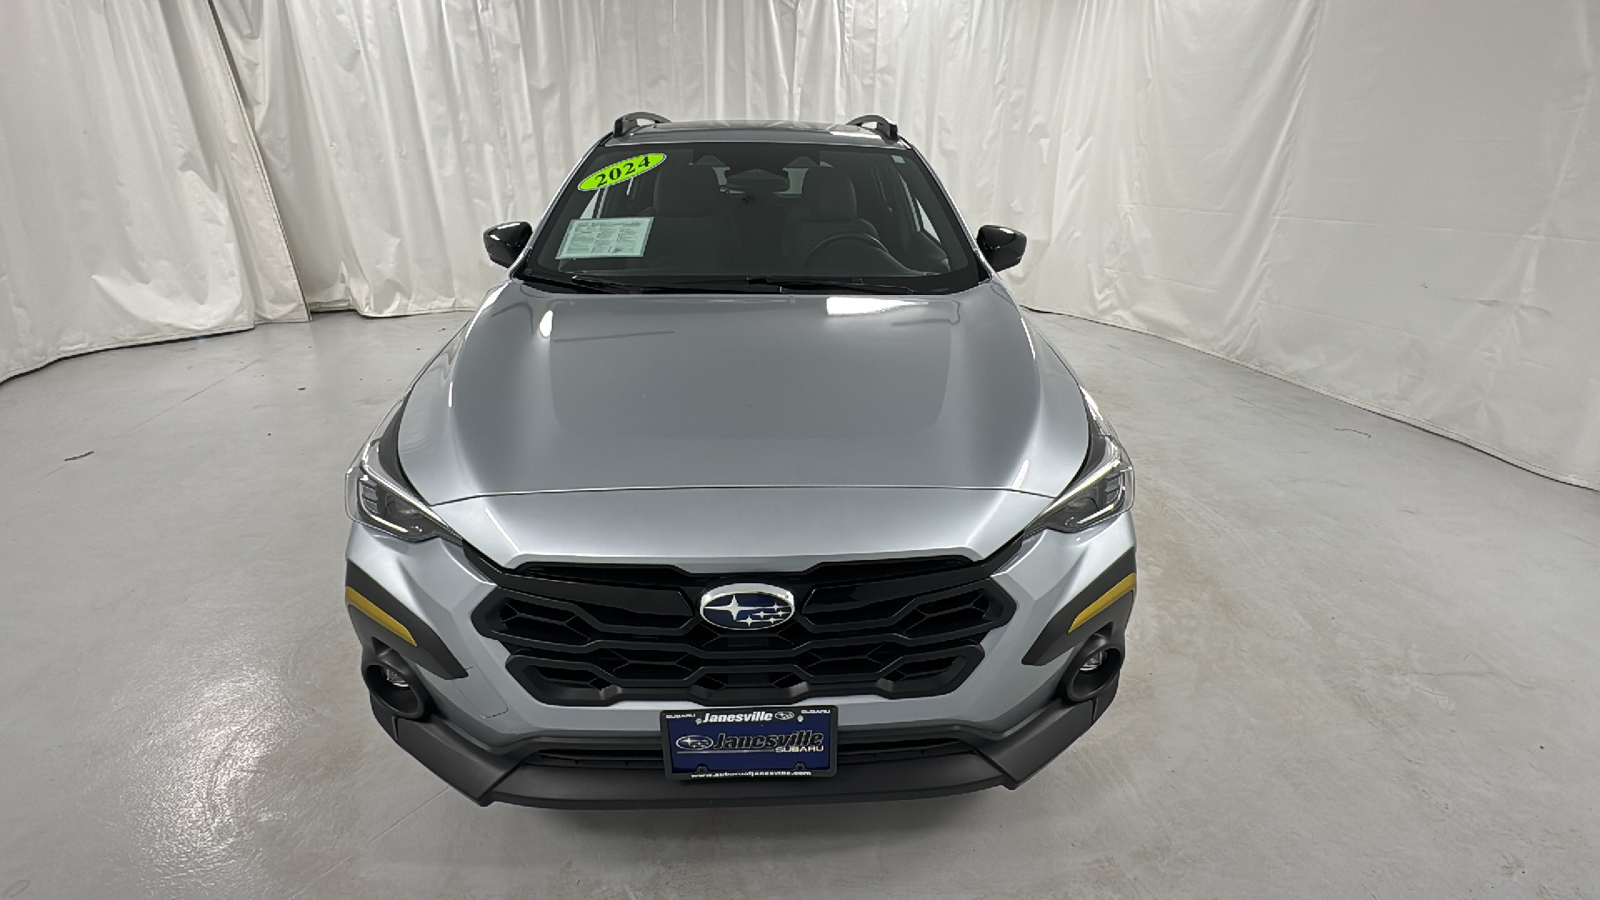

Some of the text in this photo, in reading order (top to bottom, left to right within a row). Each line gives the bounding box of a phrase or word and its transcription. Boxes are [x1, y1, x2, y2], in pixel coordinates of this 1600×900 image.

[594, 156, 650, 187] 2024
[702, 711, 774, 723] Janesville
[713, 729, 824, 749] Janesville
[774, 745, 824, 754] SUBARU
